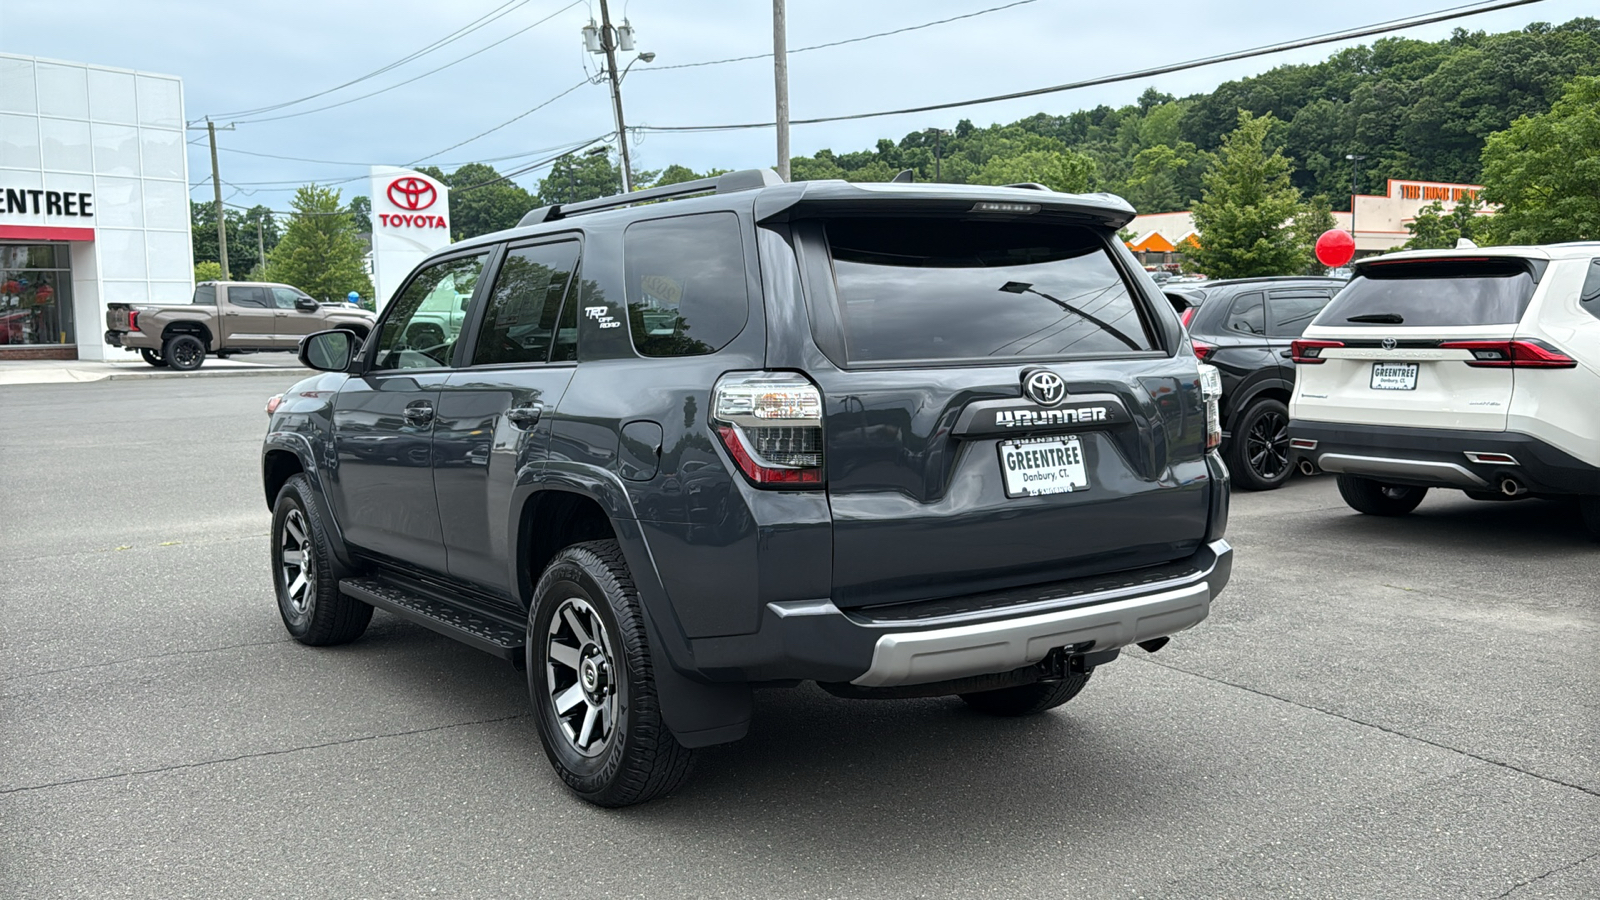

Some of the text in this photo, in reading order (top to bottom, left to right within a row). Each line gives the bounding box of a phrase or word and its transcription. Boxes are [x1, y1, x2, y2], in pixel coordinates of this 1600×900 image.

[1400, 185, 1420, 199] THE
[1422, 186, 1449, 200] HOME
[379, 213, 447, 229] TOYOTA
[585, 306, 608, 319] TRD
[1375, 367, 1415, 378] GREENTREE
[996, 407, 1107, 427] 4RUNNER
[1006, 446, 1080, 471] GREENTREE
[1022, 469, 1070, 483] Danbury, CT.
